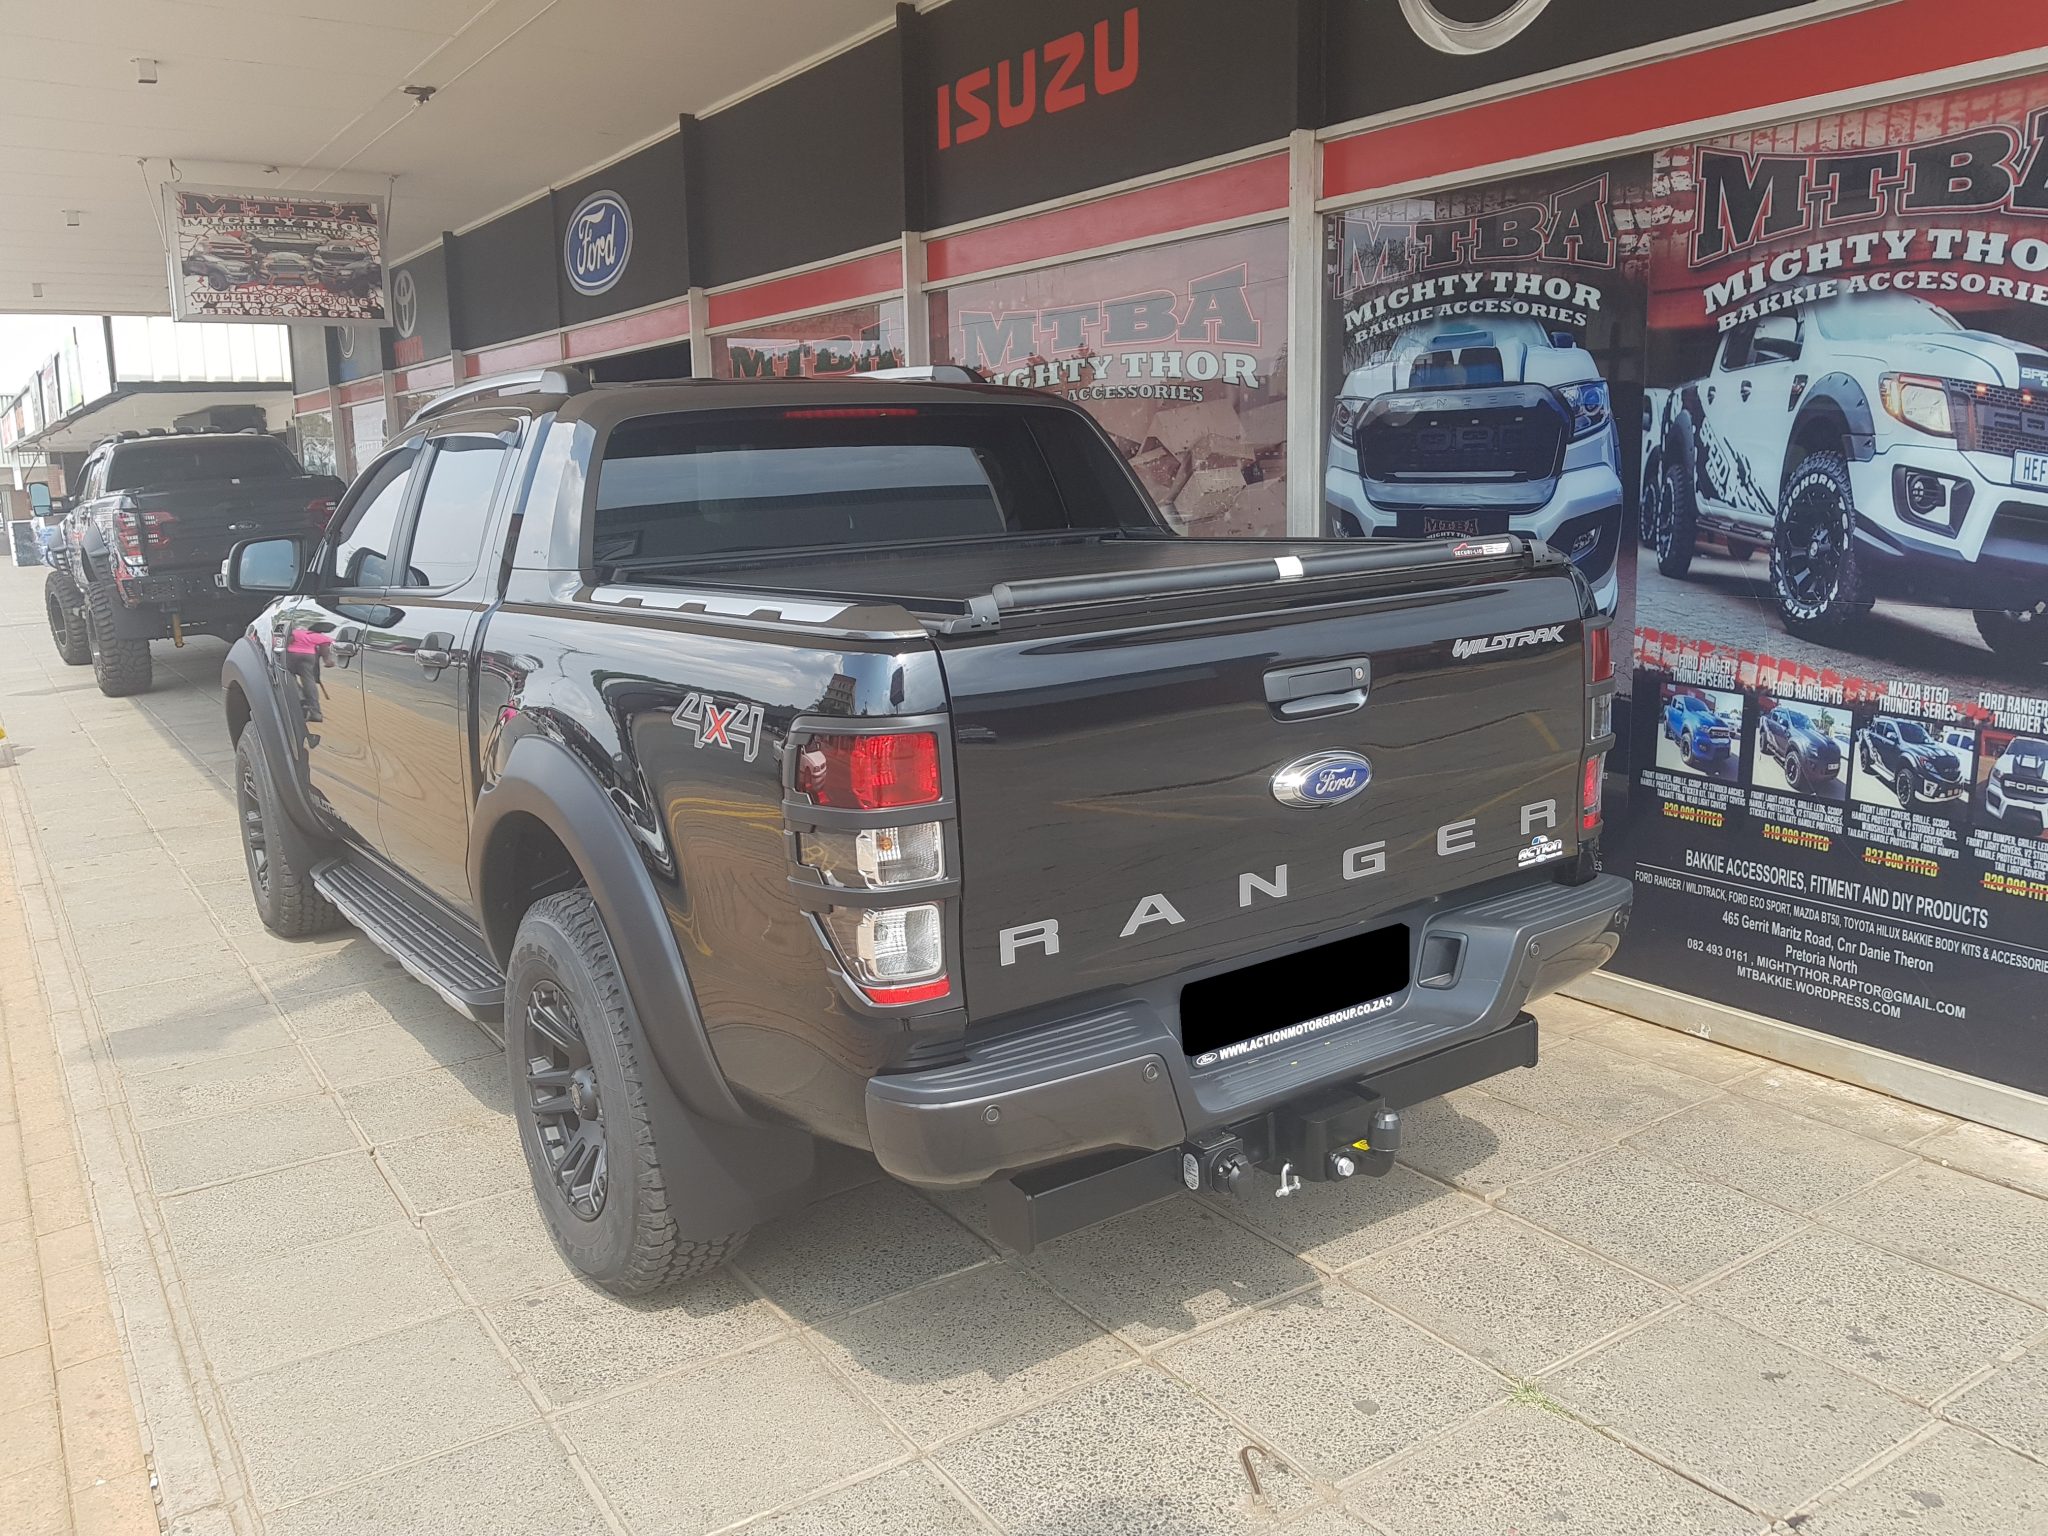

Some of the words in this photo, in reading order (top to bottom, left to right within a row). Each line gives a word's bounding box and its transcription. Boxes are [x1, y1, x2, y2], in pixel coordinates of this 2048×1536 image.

[937, 7, 1139, 150] ISUZU
[181, 194, 377, 223] MTBA
[183, 217, 300, 226] MIGHTY
[303, 219, 377, 234] THOR
[577, 204, 616, 275] Ford
[1333, 171, 1617, 299] MTBA
[1703, 229, 1917, 314] MIGHTY
[191, 292, 259, 303] WILLIE
[265, 294, 297, 304] 082
[302, 295, 334, 305] 493
[201, 307, 243, 315] BEN
[1345, 272, 1482, 331] MIGHTY
[1490, 272, 1602, 311] THOR
[1717, 279, 1838, 333] BAKKIE
[959, 262, 1261, 372] MTBA
[1353, 306, 1434, 344] BAKKIE
[1439, 300, 1588, 327] ACCESORIES
[985, 355, 1113, 388] IGHTY
[1121, 351, 1259, 389] THOR
[1067, 384, 1204, 402] ACCESSORIES
[1452, 625, 1564, 659] WILDTRAK
[1672, 667, 1706, 686] THUNDER
[1707, 673, 1736, 690] SERIES
[1678, 654, 1698, 670] FORD
[1699, 656, 1732, 674] RANGER
[1772, 681, 1794, 698] FORD
[1795, 684, 1830, 702] RANGER
[1831, 689, 1843, 704] T6
[1878, 695, 1921, 716] THUNDER
[1923, 702, 1957, 721] SERIES
[1888, 681, 1921, 700] MAZDA
[1923, 686, 1949, 704] BT50
[1978, 692, 2005, 709] FORD
[1994, 711, 2041, 733] THUNDER
[1315, 767, 1357, 794] Ford
[1696, 808, 1723, 827] FITTED
[1800, 831, 1829, 851] FITTED
[1000, 798, 1557, 967] RANGER
[1905, 856, 1938, 877] FITTED
[1686, 849, 1724, 874] BAKKIE
[1726, 857, 1807, 894] ACCESSORIES,
[1809, 874, 1861, 900] FITMENT
[1862, 885, 1889, 908] AND
[1892, 891, 1914, 914] DIY
[1915, 895, 1989, 929] PRODUCTS
[1635, 870, 1653, 884] FORD
[1653, 874, 1682, 891] RANGER
[1686, 882, 1728, 901] WILDTRACK,
[1728, 891, 1748, 905] FORD
[1749, 896, 1765, 909] ECO
[1766, 899, 1792, 917] SPORT,
[1793, 905, 1820, 922] MAZDA
[1821, 911, 1842, 928] BT50,
[1843, 916, 1875, 934] TOYOTA
[1876, 923, 1900, 940] HILUX
[1902, 929, 1933, 947] BAKKIE
[1935, 936, 1960, 953] BODY
[1961, 942, 1981, 958] KITS
[1982, 947, 1990, 960] &
[1722, 911, 1740, 926] 465
[1741, 915, 1769, 934] Gerrit
[1771, 921, 1802, 942] Maritz
[1804, 929, 1834, 951] Road,
[1837, 937, 1857, 954] Cnr
[1859, 941, 1891, 962] Danie
[1894, 950, 1934, 973] Theron
[1785, 945, 1826, 967] Pretoria
[1828, 955, 1858, 975] North
[1687, 938, 1704, 951] 082
[1706, 944, 1723, 957] 493
[1725, 948, 1748, 963] 0161
[1757, 955, 1966, 1019] MIGHTYTHOR.RAPTOR@GMAIL.COM
[1737, 965, 1901, 1018] MTBAKKIE.WORDPRESS.COM
[1219, 999, 1385, 1060] WWW.ACTIONMOTORGROUP.CO.ZA
